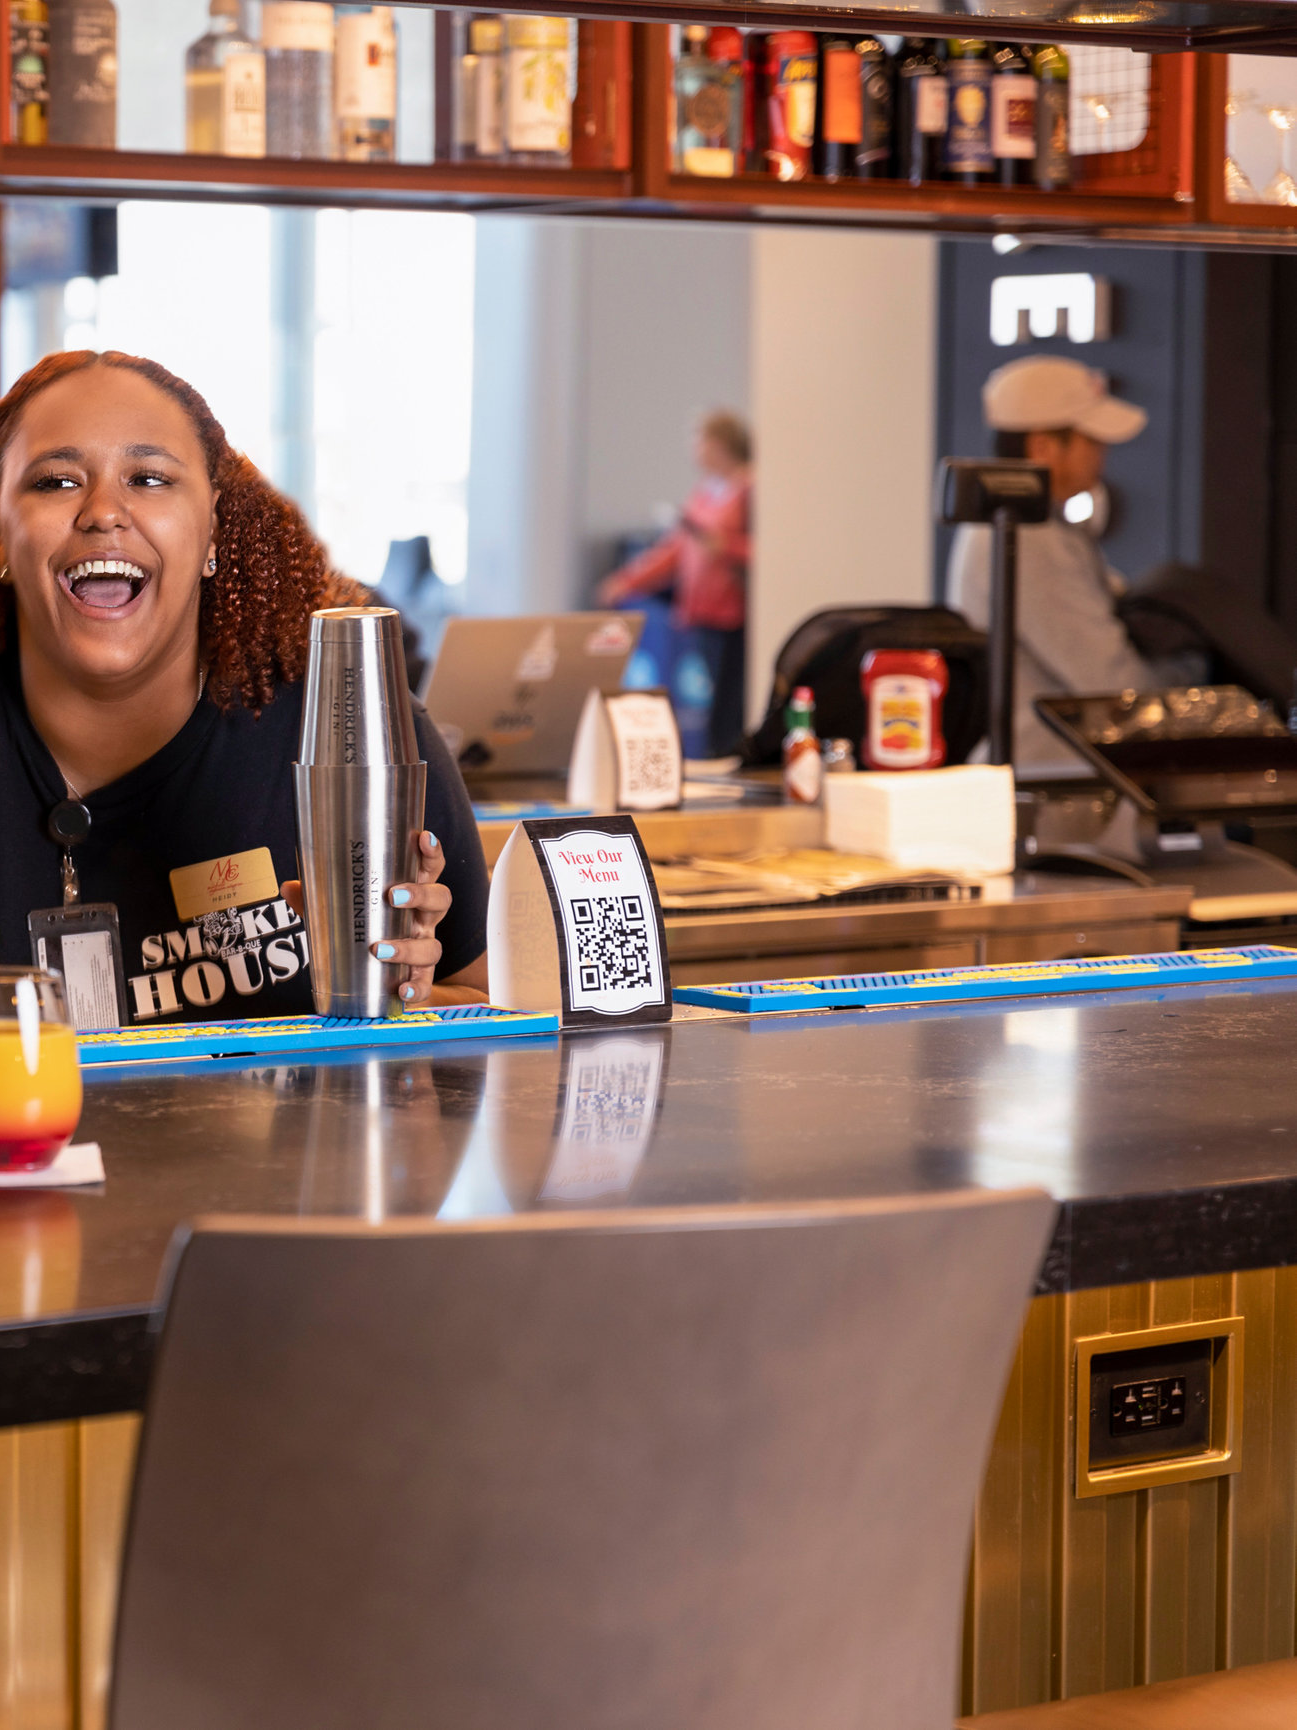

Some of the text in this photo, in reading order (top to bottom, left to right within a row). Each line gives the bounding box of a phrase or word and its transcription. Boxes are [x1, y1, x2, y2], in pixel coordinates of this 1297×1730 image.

[344, 667, 358, 765] HENDRICK'S
[558, 849, 622, 865] View Our
[578, 865, 620, 883] Menu
[351, 840, 365, 943] HENDRICK'S
[220, 938, 262, 960] BAR-B-QUE
